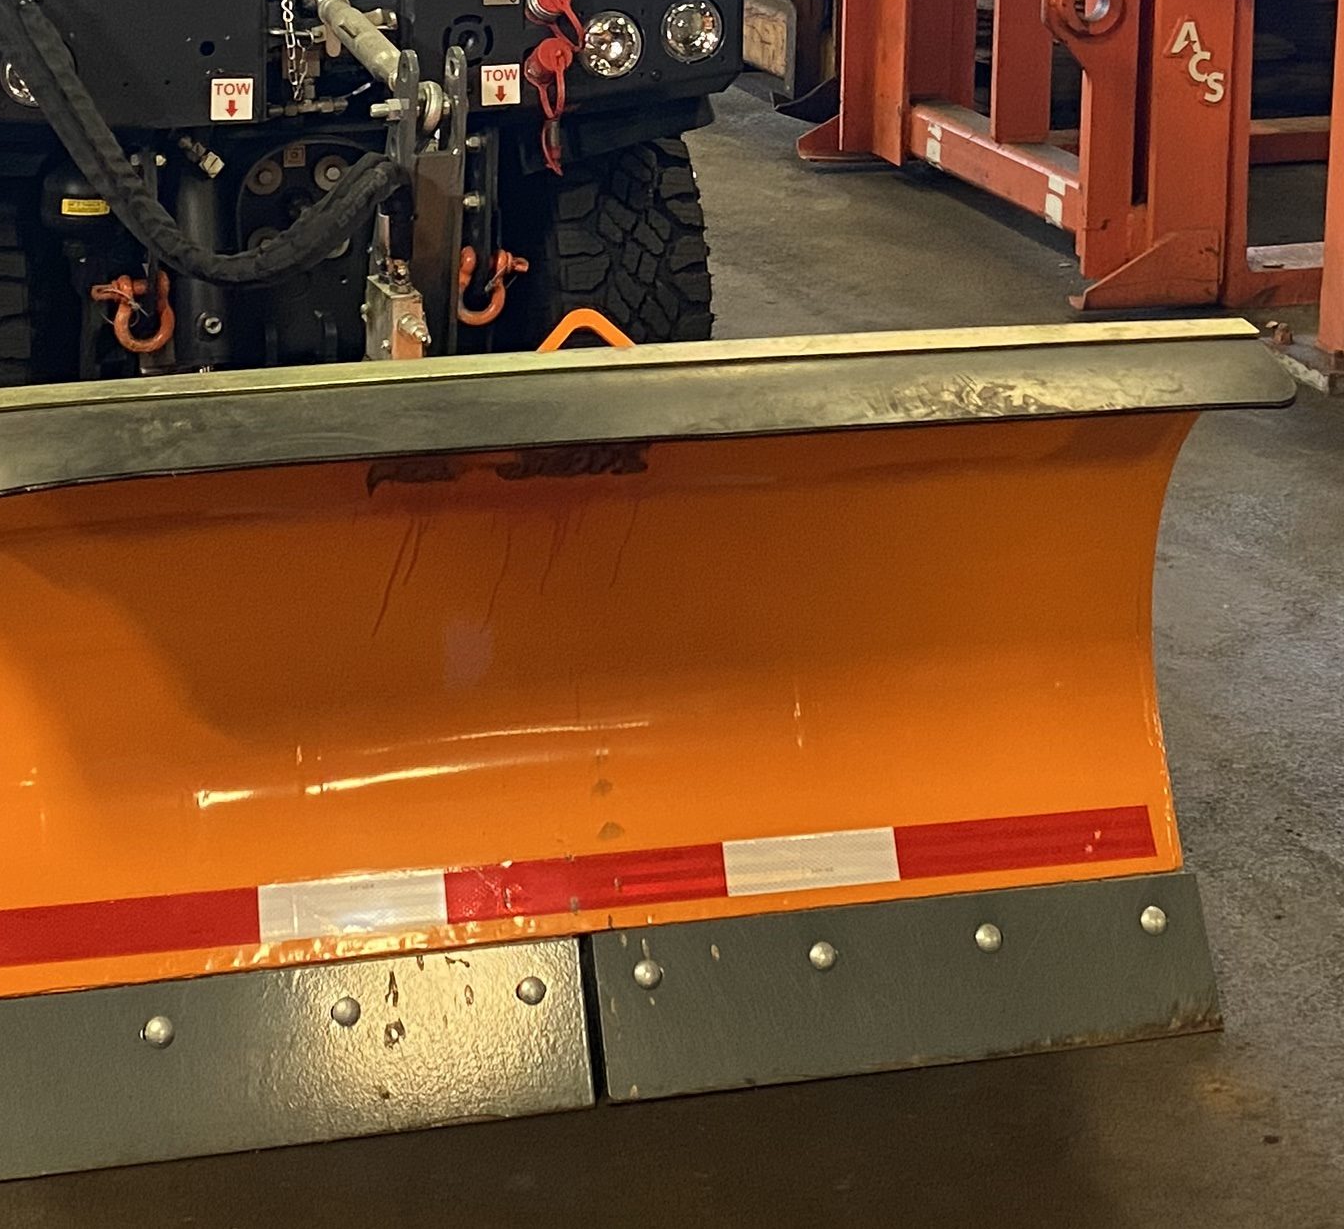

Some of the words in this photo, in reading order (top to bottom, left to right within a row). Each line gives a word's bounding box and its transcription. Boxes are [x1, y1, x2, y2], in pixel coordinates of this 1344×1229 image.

[1171, 21, 1225, 103] ACS
[483, 67, 518, 82] TOW
[214, 82, 251, 96] TOW
